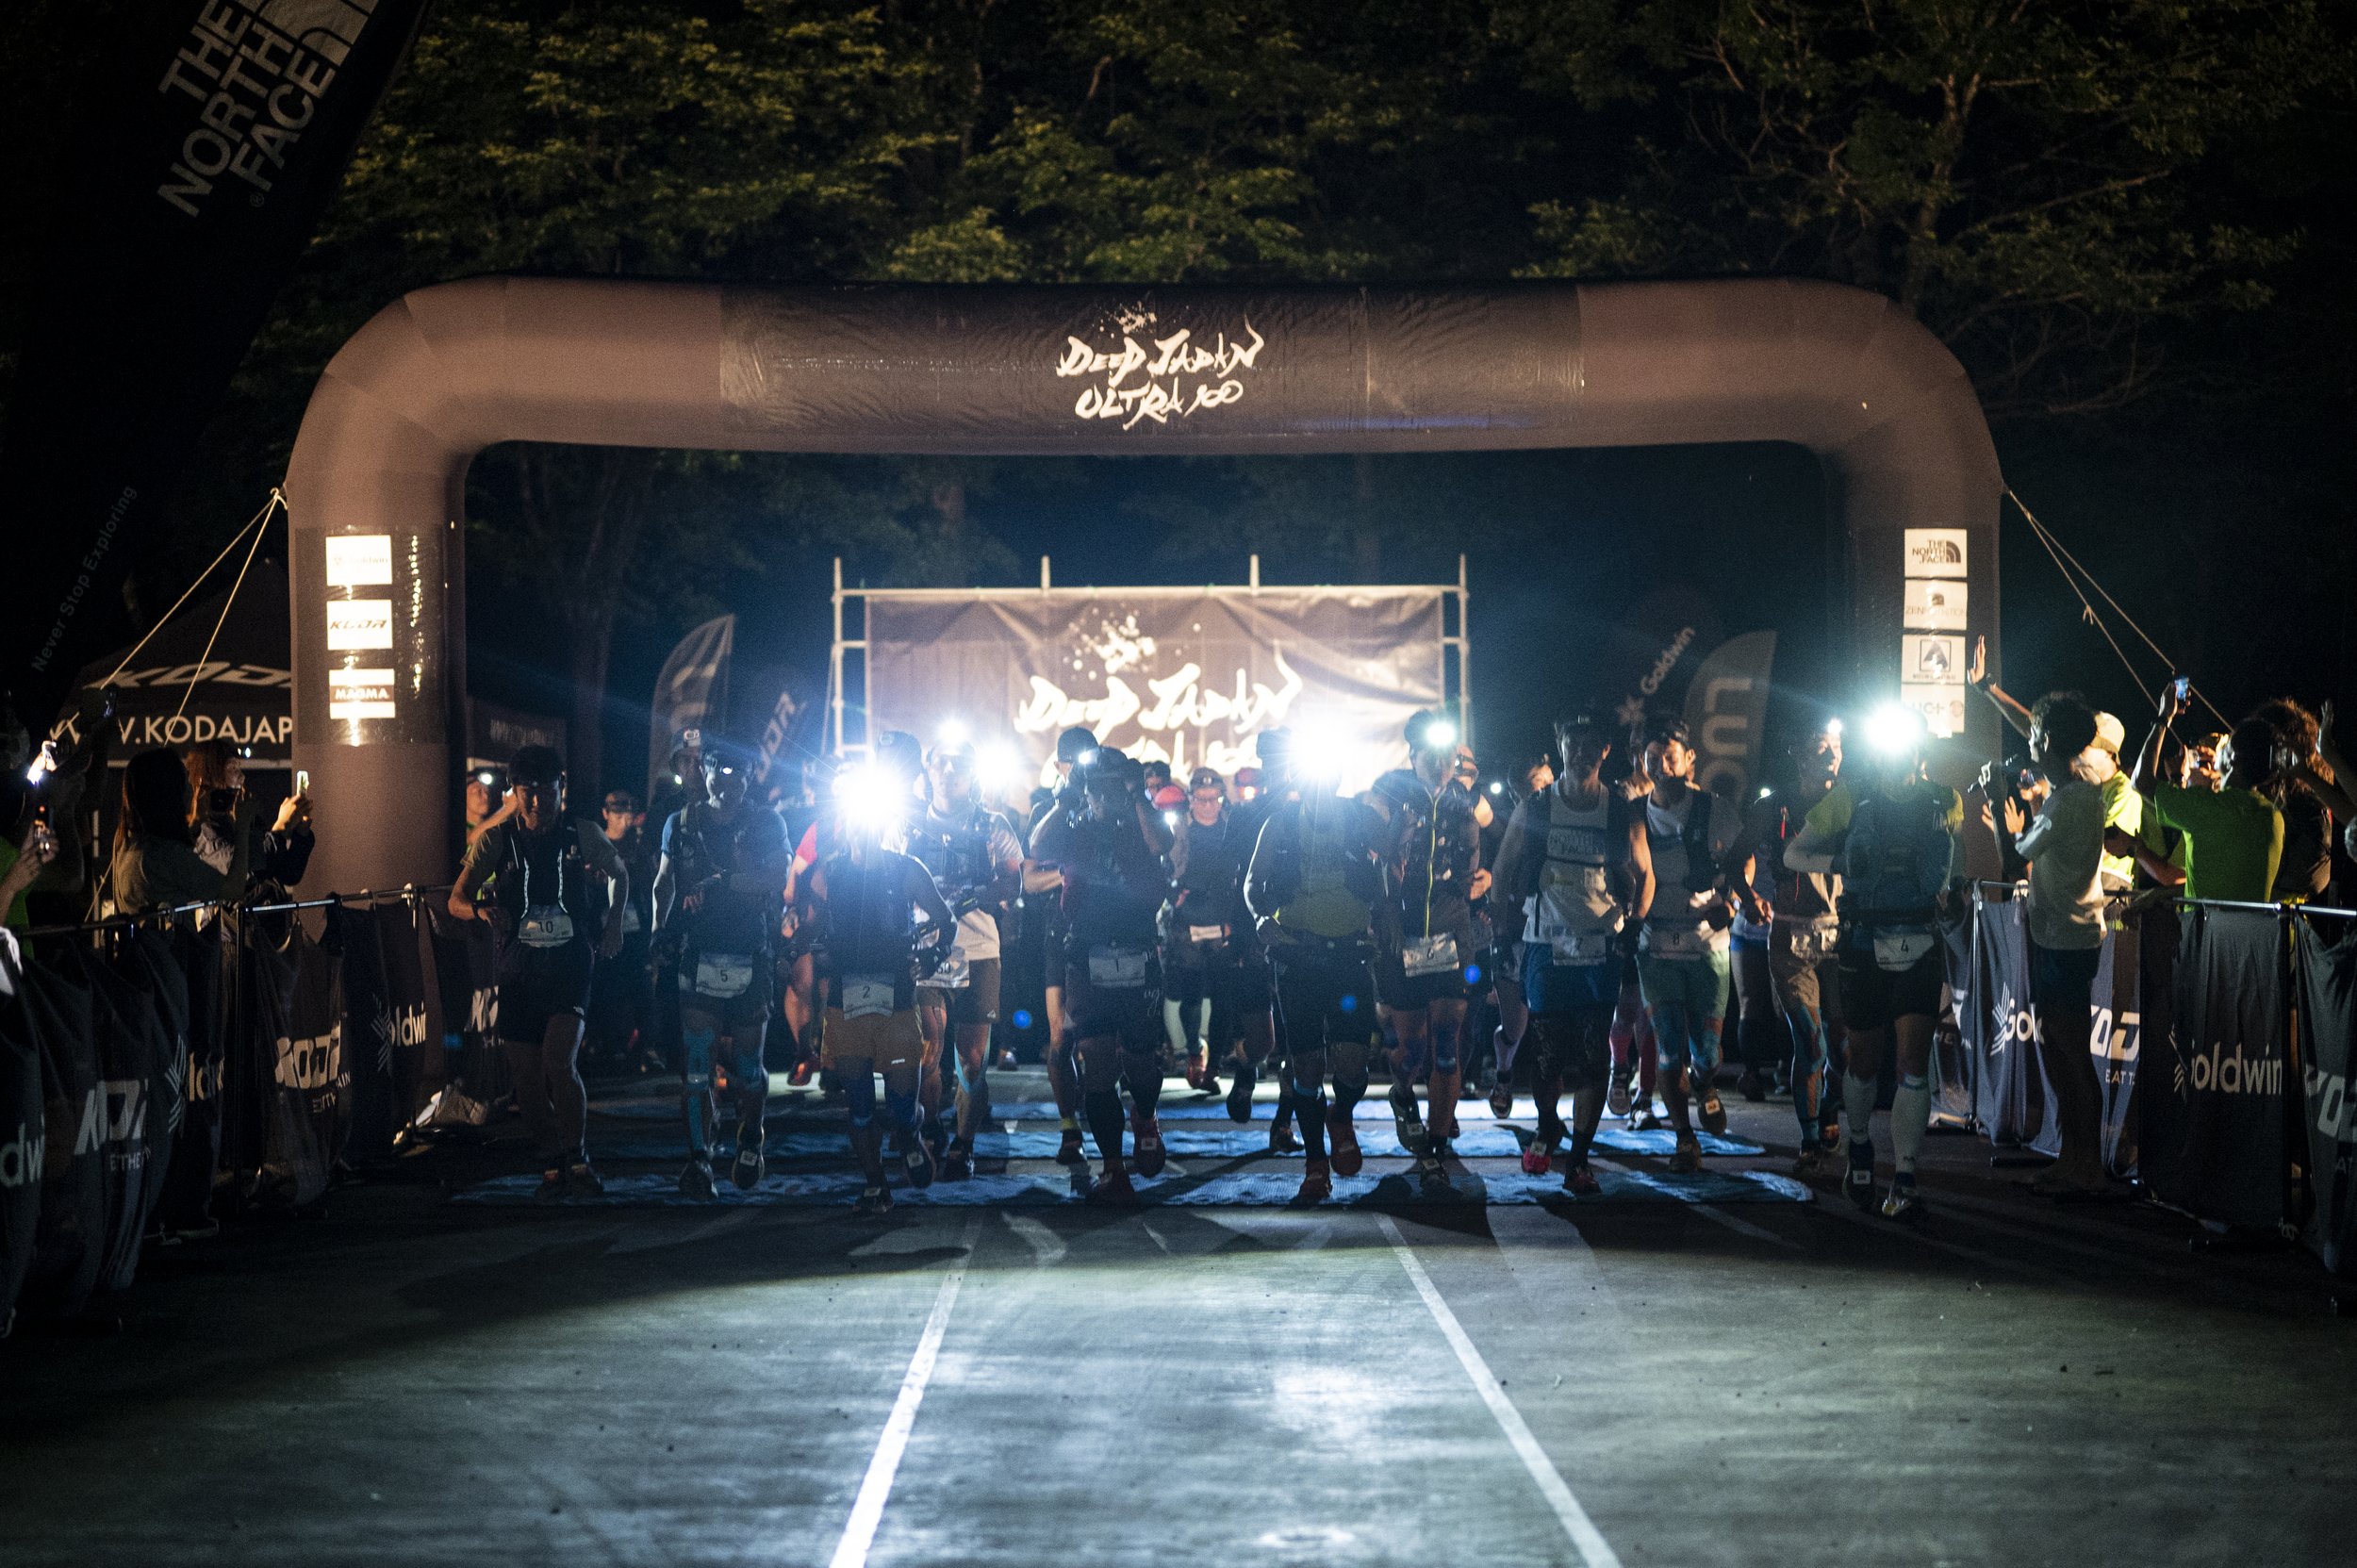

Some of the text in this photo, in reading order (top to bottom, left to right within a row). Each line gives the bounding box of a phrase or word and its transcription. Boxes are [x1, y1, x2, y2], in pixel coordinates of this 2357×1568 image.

[158, 0, 252, 102] THE
[157, 19, 295, 218] NORTH
[229, 48, 337, 192] FACE
[1075, 377, 1183, 431] ULTRA
[31, 618, 66, 671] Never
[59, 572, 91, 618] Stop
[83, 486, 138, 571] Exploring
[1912, 548, 1946, 556] NORTH
[1927, 538, 1946, 548] THE
